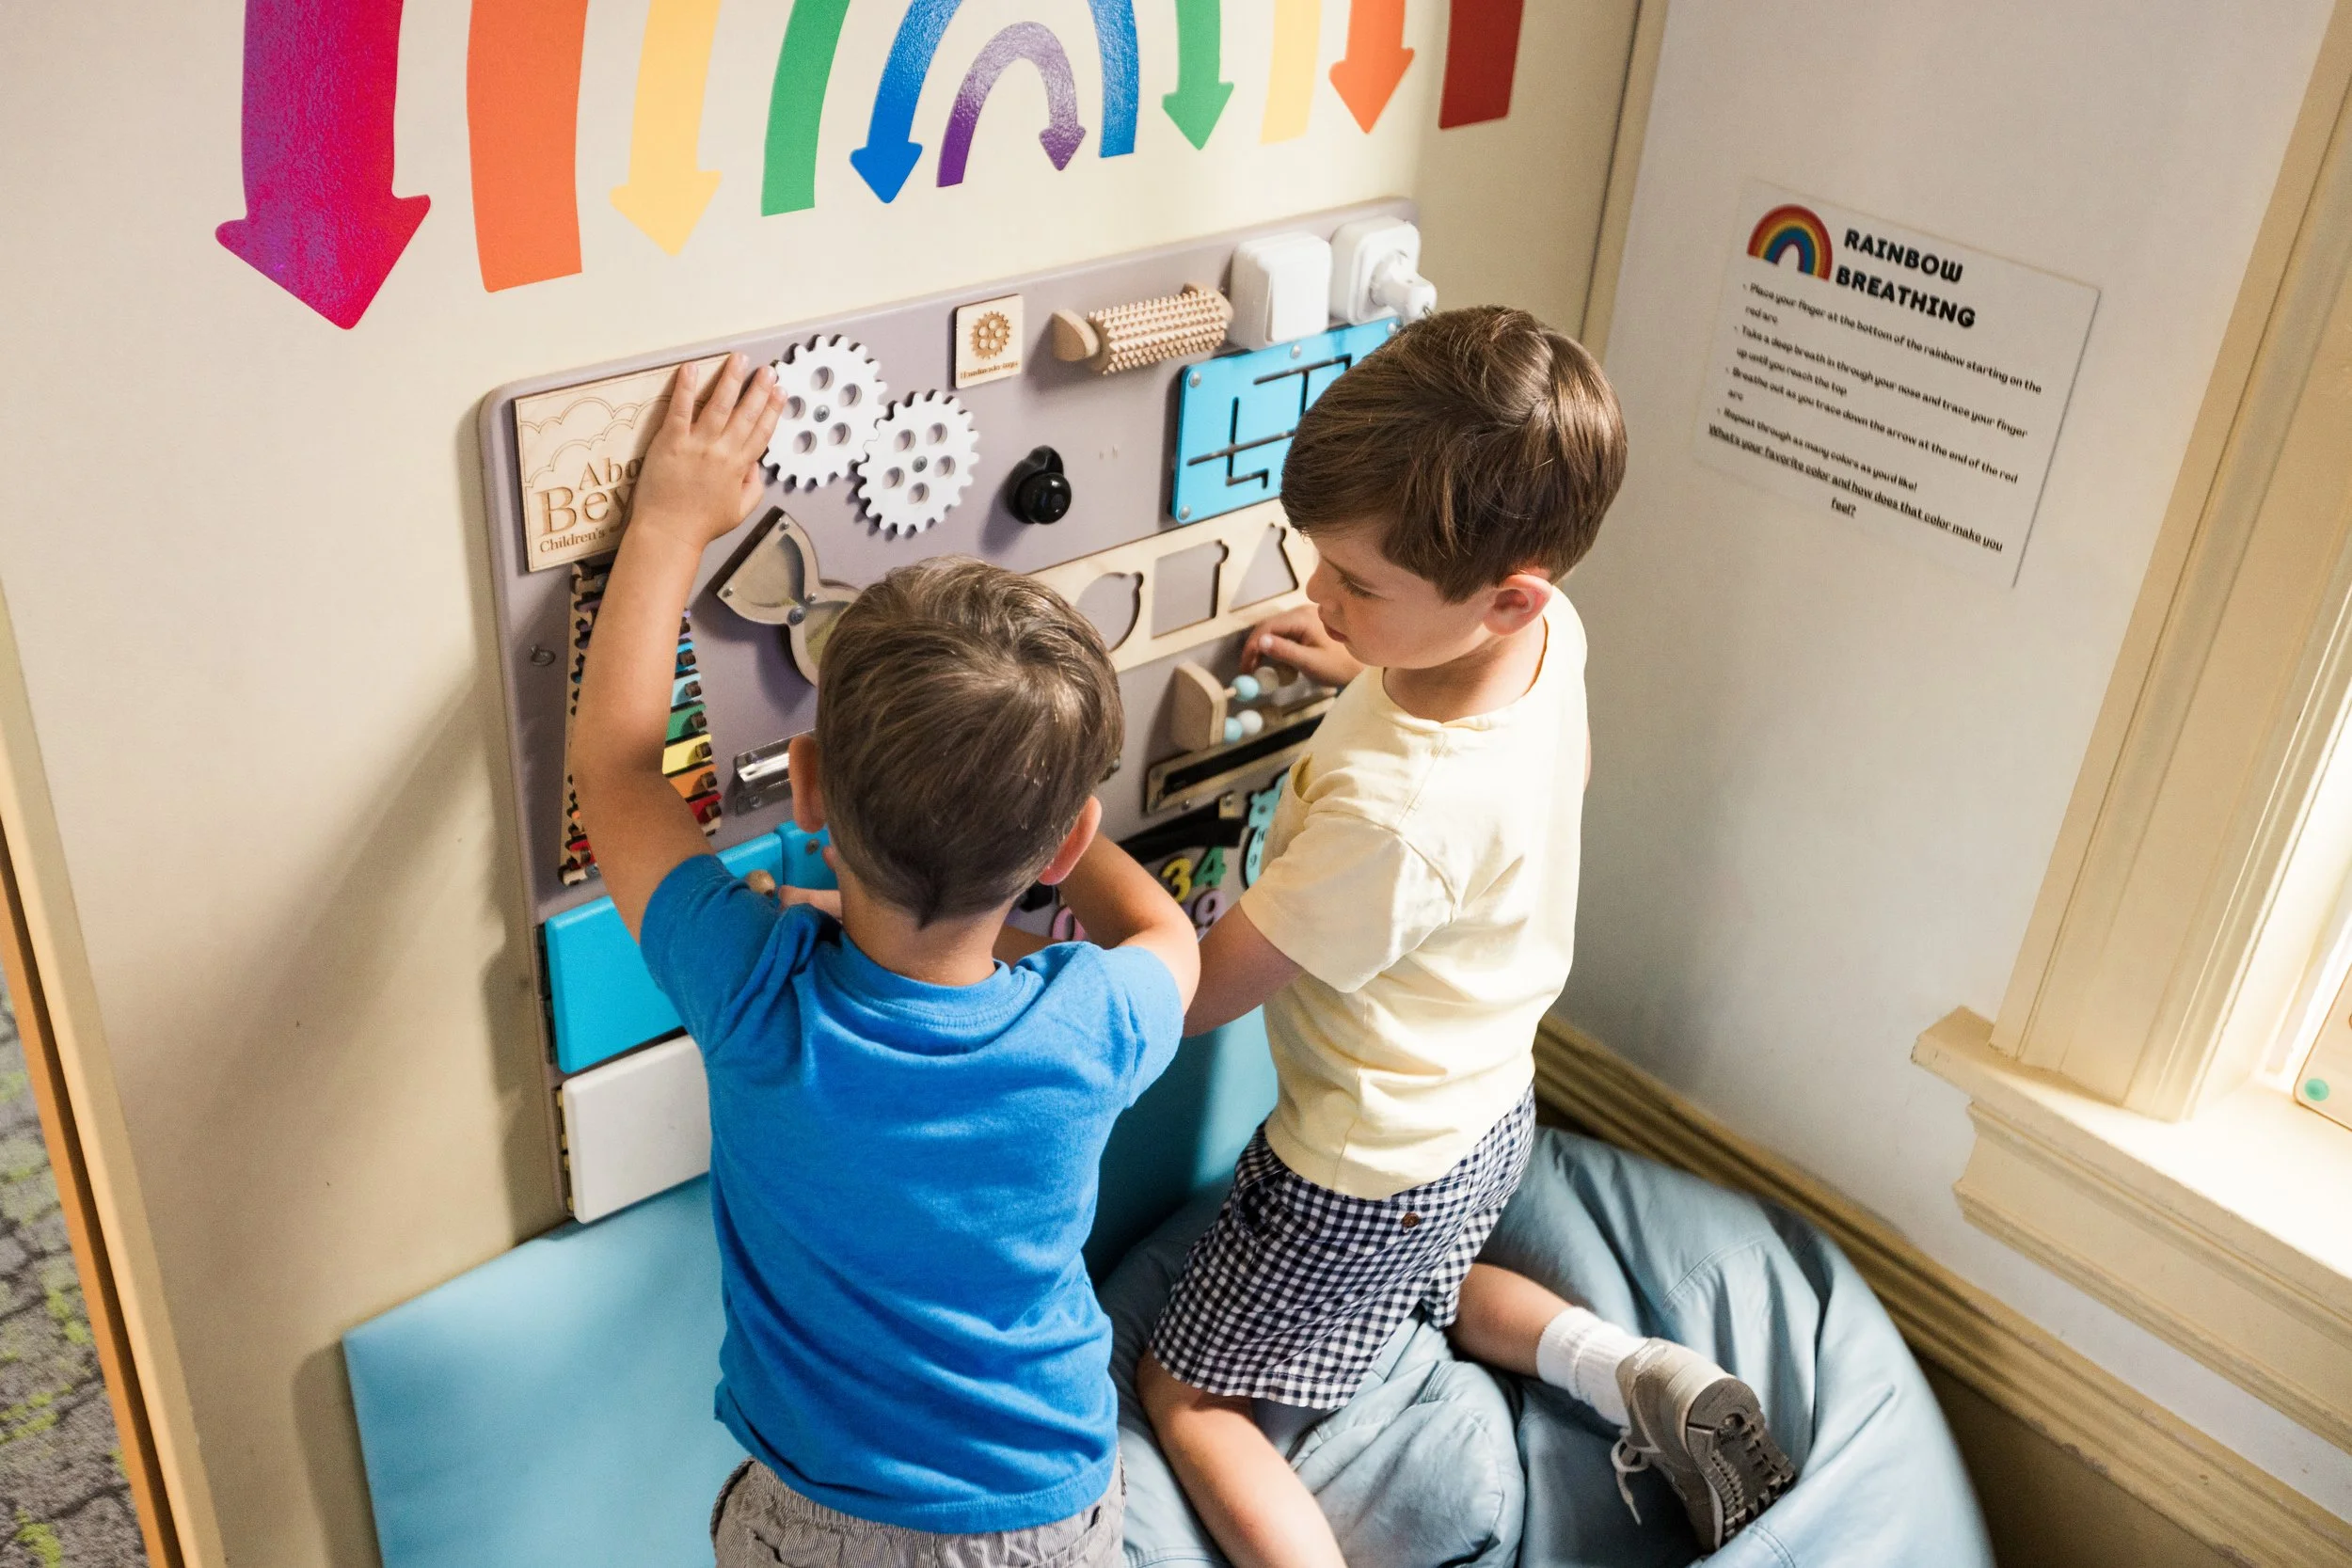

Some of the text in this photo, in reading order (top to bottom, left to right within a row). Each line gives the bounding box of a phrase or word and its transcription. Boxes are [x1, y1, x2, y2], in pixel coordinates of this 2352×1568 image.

[1844, 229, 1963, 282] RAINBOW
[1744, 305, 1762, 319] red
[1836, 265, 1976, 327] BREATHING
[1749, 282, 2042, 395] Place your finger at the bottom of the rainbow starting on the
[1736, 347, 1748, 359] up
[1767, 360, 1786, 372] you
[1786, 366, 1813, 384] reach
[1814, 375, 1829, 389] the
[1831, 381, 1847, 397] top
[1741, 324, 2027, 438] Take a deep breath in through your nose and trace your finger
[1731, 366, 2018, 484] Breathe out as you trace down the arrow at the end of the red
[1756, 420, 1791, 442] through
[1791, 436, 1804, 448] as
[1804, 440, 1830, 460] many
[1830, 451, 1859, 470] colors
[1859, 463, 1871, 475] as
[579, 456, 645, 490] Abo
[1740, 438, 1763, 456] your
[1762, 446, 1804, 472] favorite
[1804, 464, 1831, 483] color
[1830, 474, 1851, 491] and
[1851, 480, 1873, 499] how
[1872, 490, 1898, 510] does
[1898, 500, 1923, 520] that
[1922, 512, 1951, 531] color
[1950, 523, 1981, 544] make
[1981, 535, 2003, 552] you
[533, 484, 638, 536] Bey
[539, 528, 606, 553] Children's
[1161, 847, 1227, 903] 3 4
